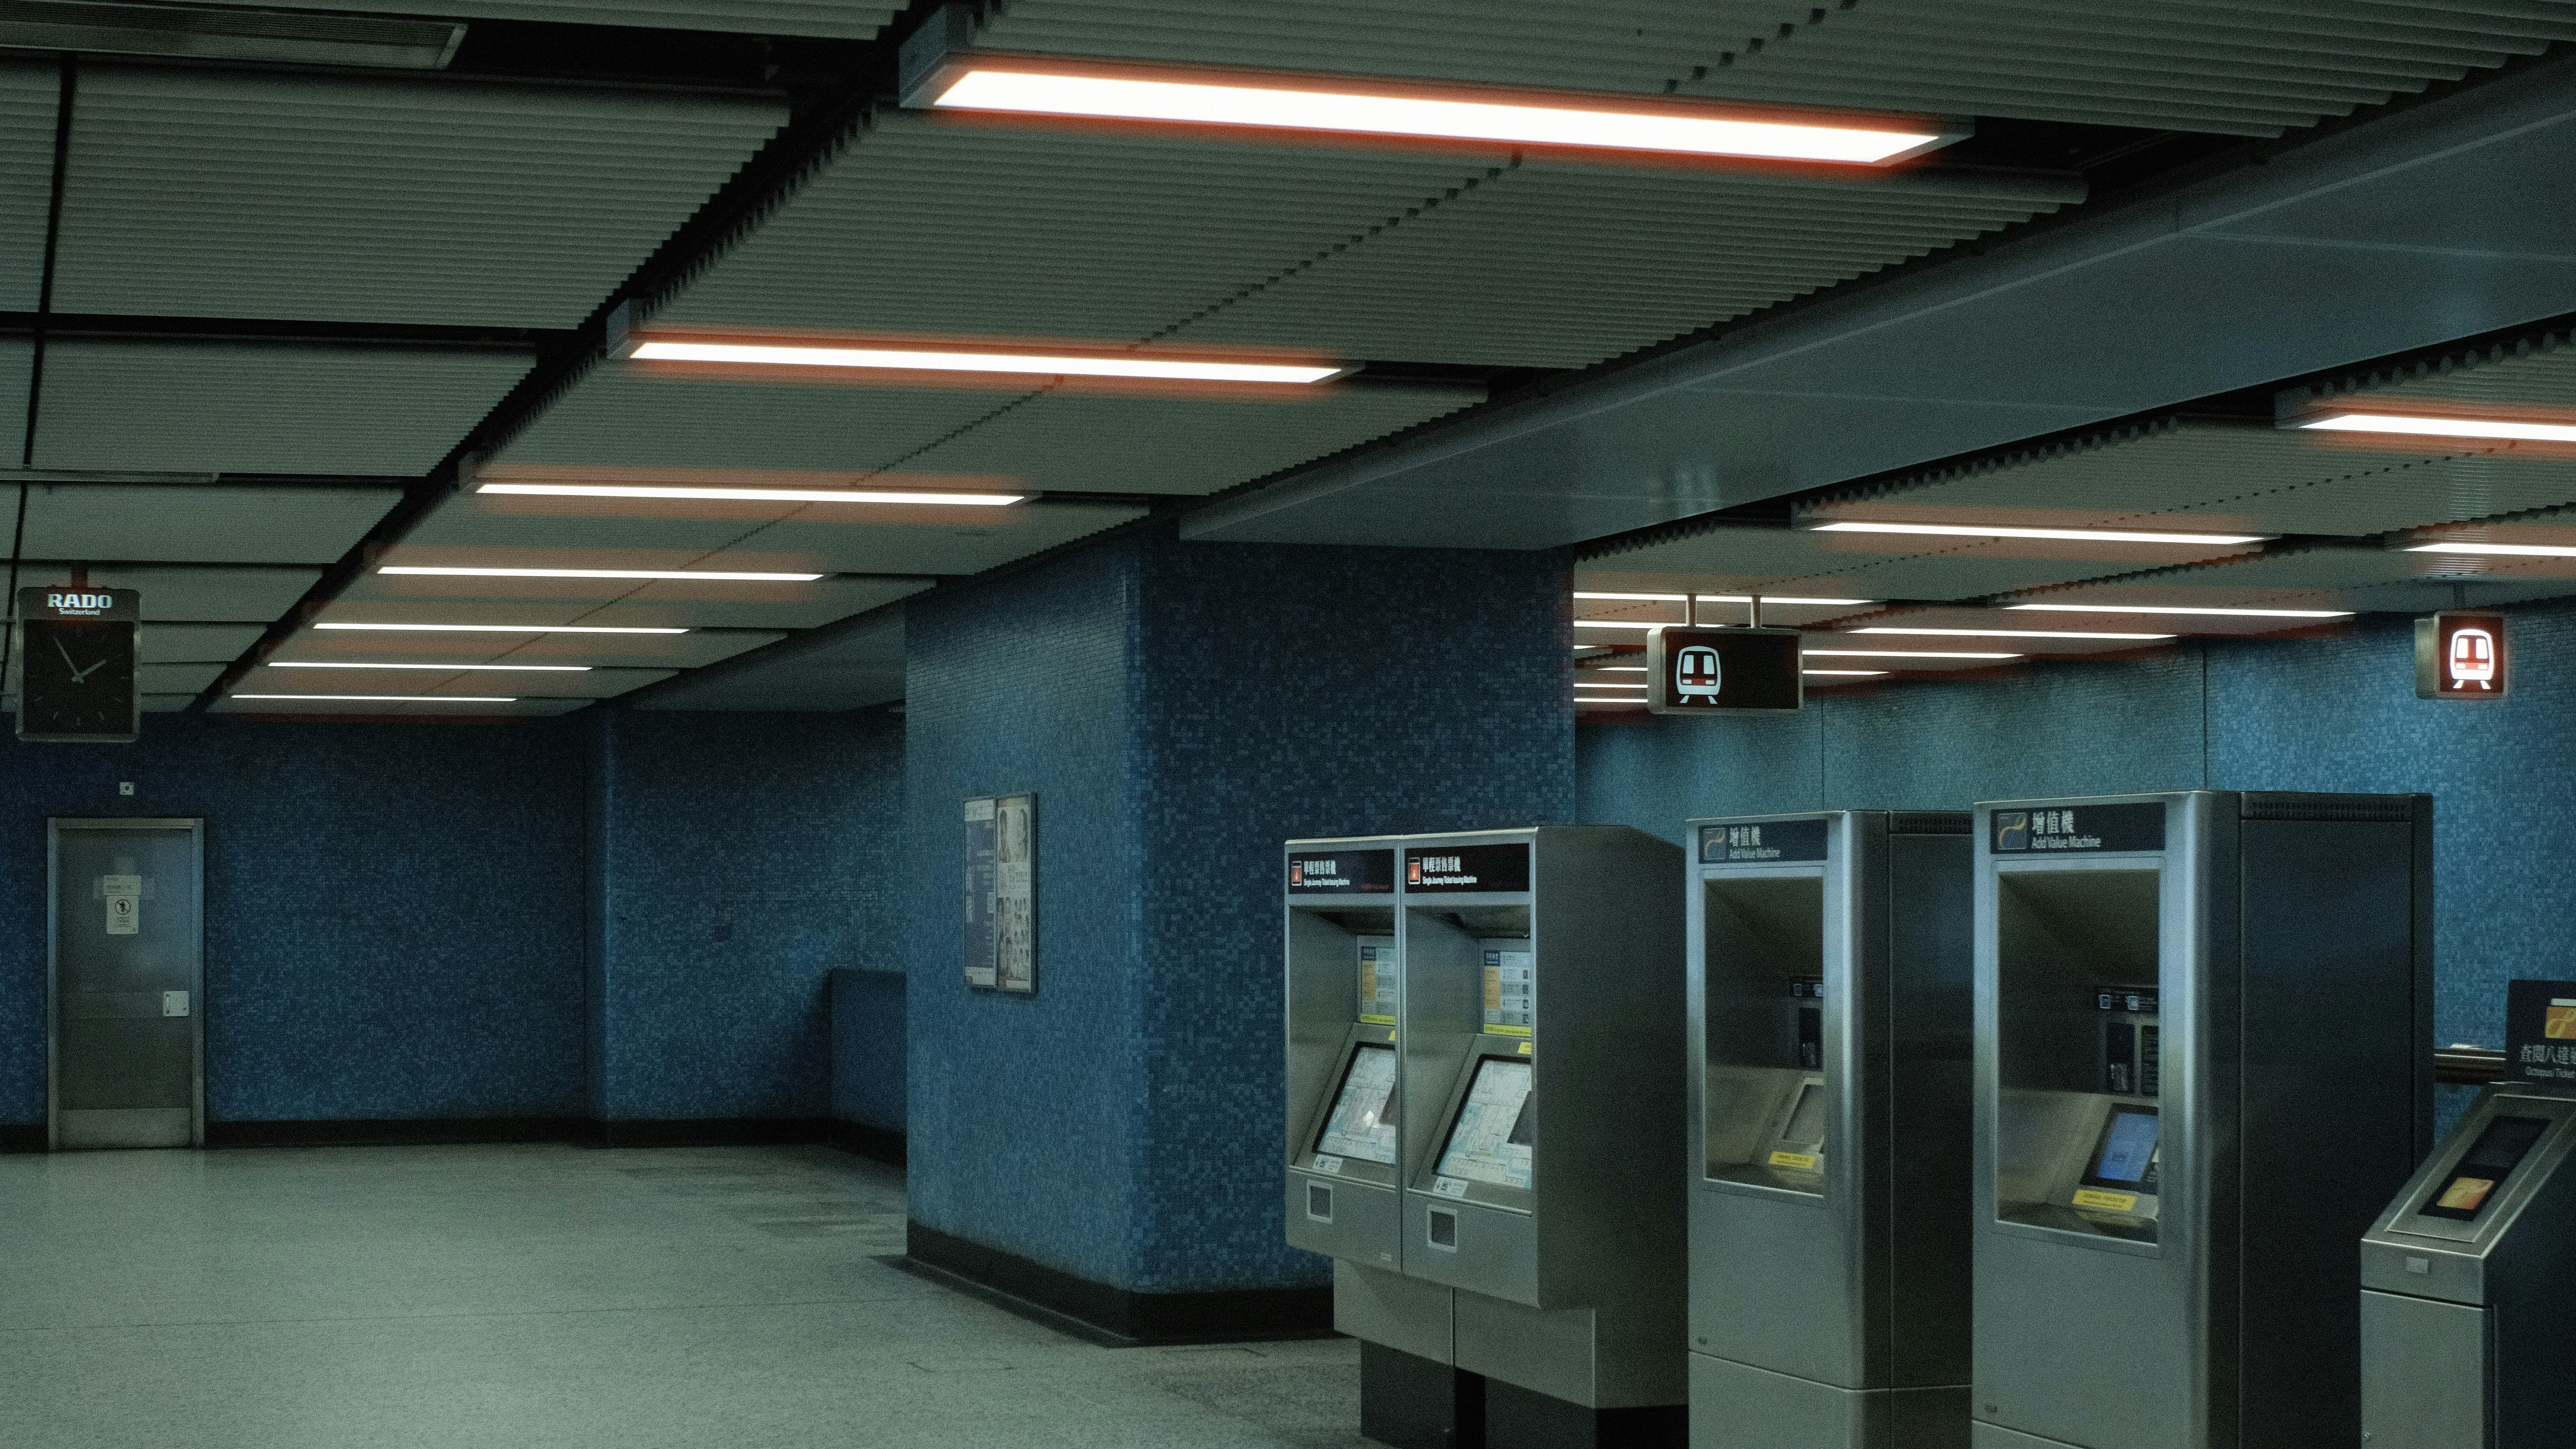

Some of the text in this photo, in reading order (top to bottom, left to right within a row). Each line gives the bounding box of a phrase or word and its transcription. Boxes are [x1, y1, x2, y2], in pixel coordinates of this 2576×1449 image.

[47, 594, 113, 608] RADO
[2032, 811, 2074, 835] 增值機
[1729, 826, 1761, 847] 增值機
[2032, 835, 2101, 849] Add Value Machine
[1729, 847, 1780, 859] Add Value Machine
